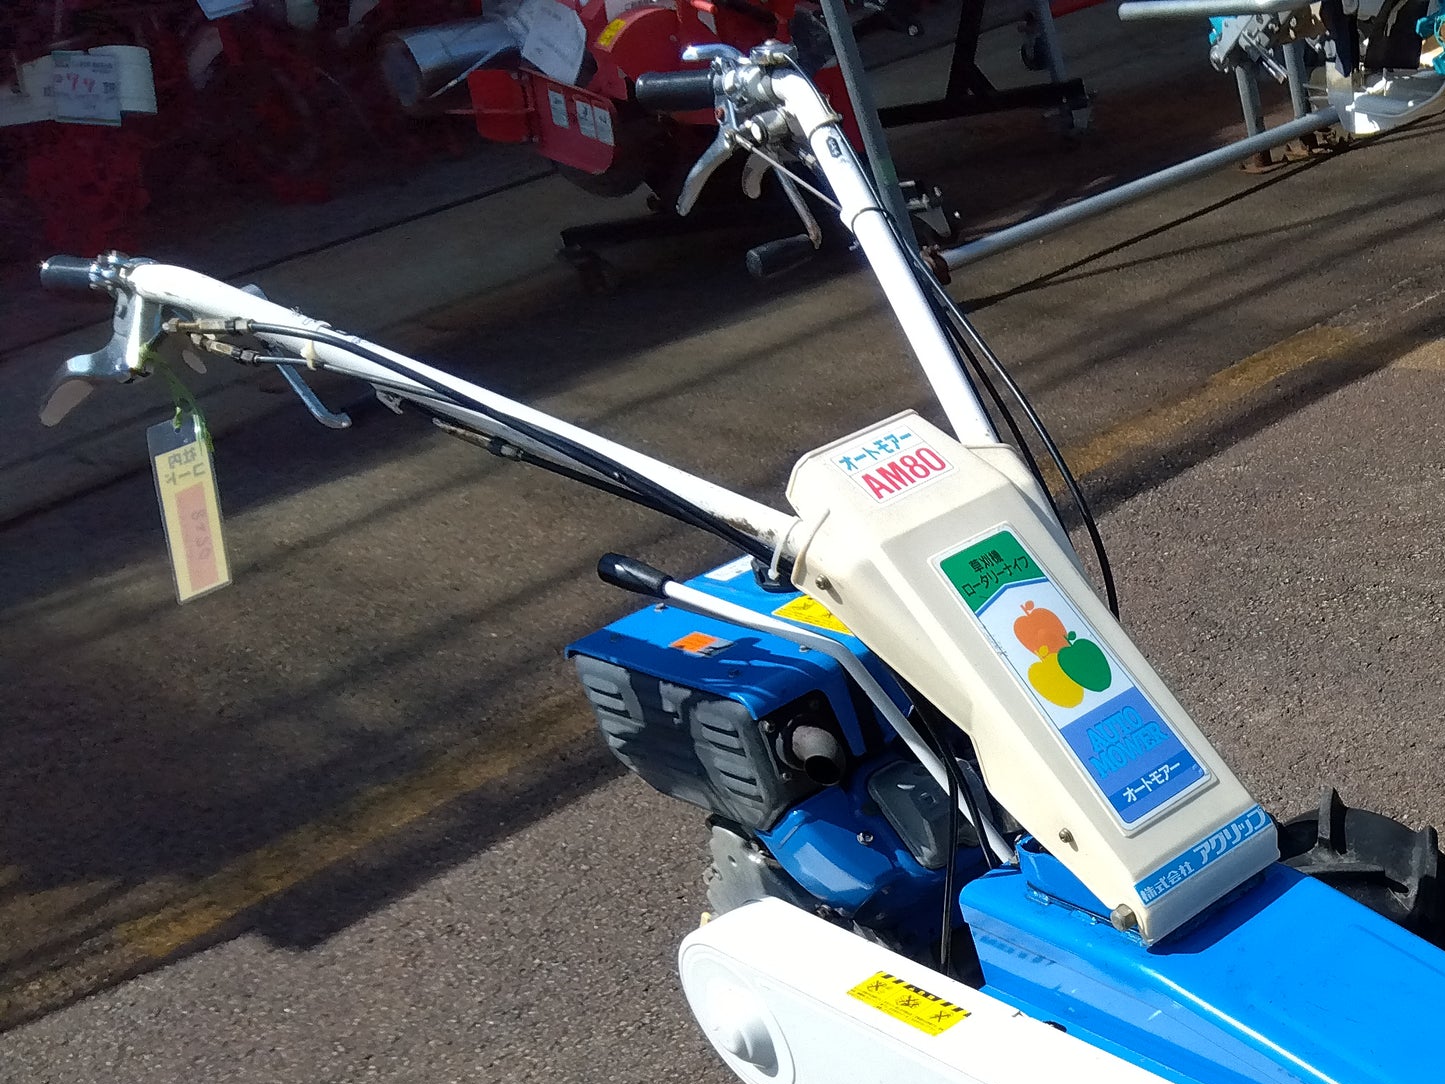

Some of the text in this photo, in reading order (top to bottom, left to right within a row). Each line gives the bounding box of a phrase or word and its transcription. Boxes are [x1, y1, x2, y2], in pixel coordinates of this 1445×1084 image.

[839, 432, 912, 471] オートモアー
[861, 447, 946, 500] AM80
[961, 555, 1029, 597] ロータリーナイフ
[968, 550, 1004, 573] 草刈機
[1086, 705, 1142, 753] AUTO
[1088, 720, 1170, 779] MOWER
[1122, 762, 1180, 803] オートモアー
[1140, 807, 1266, 902] 株式会社 アクリップ
